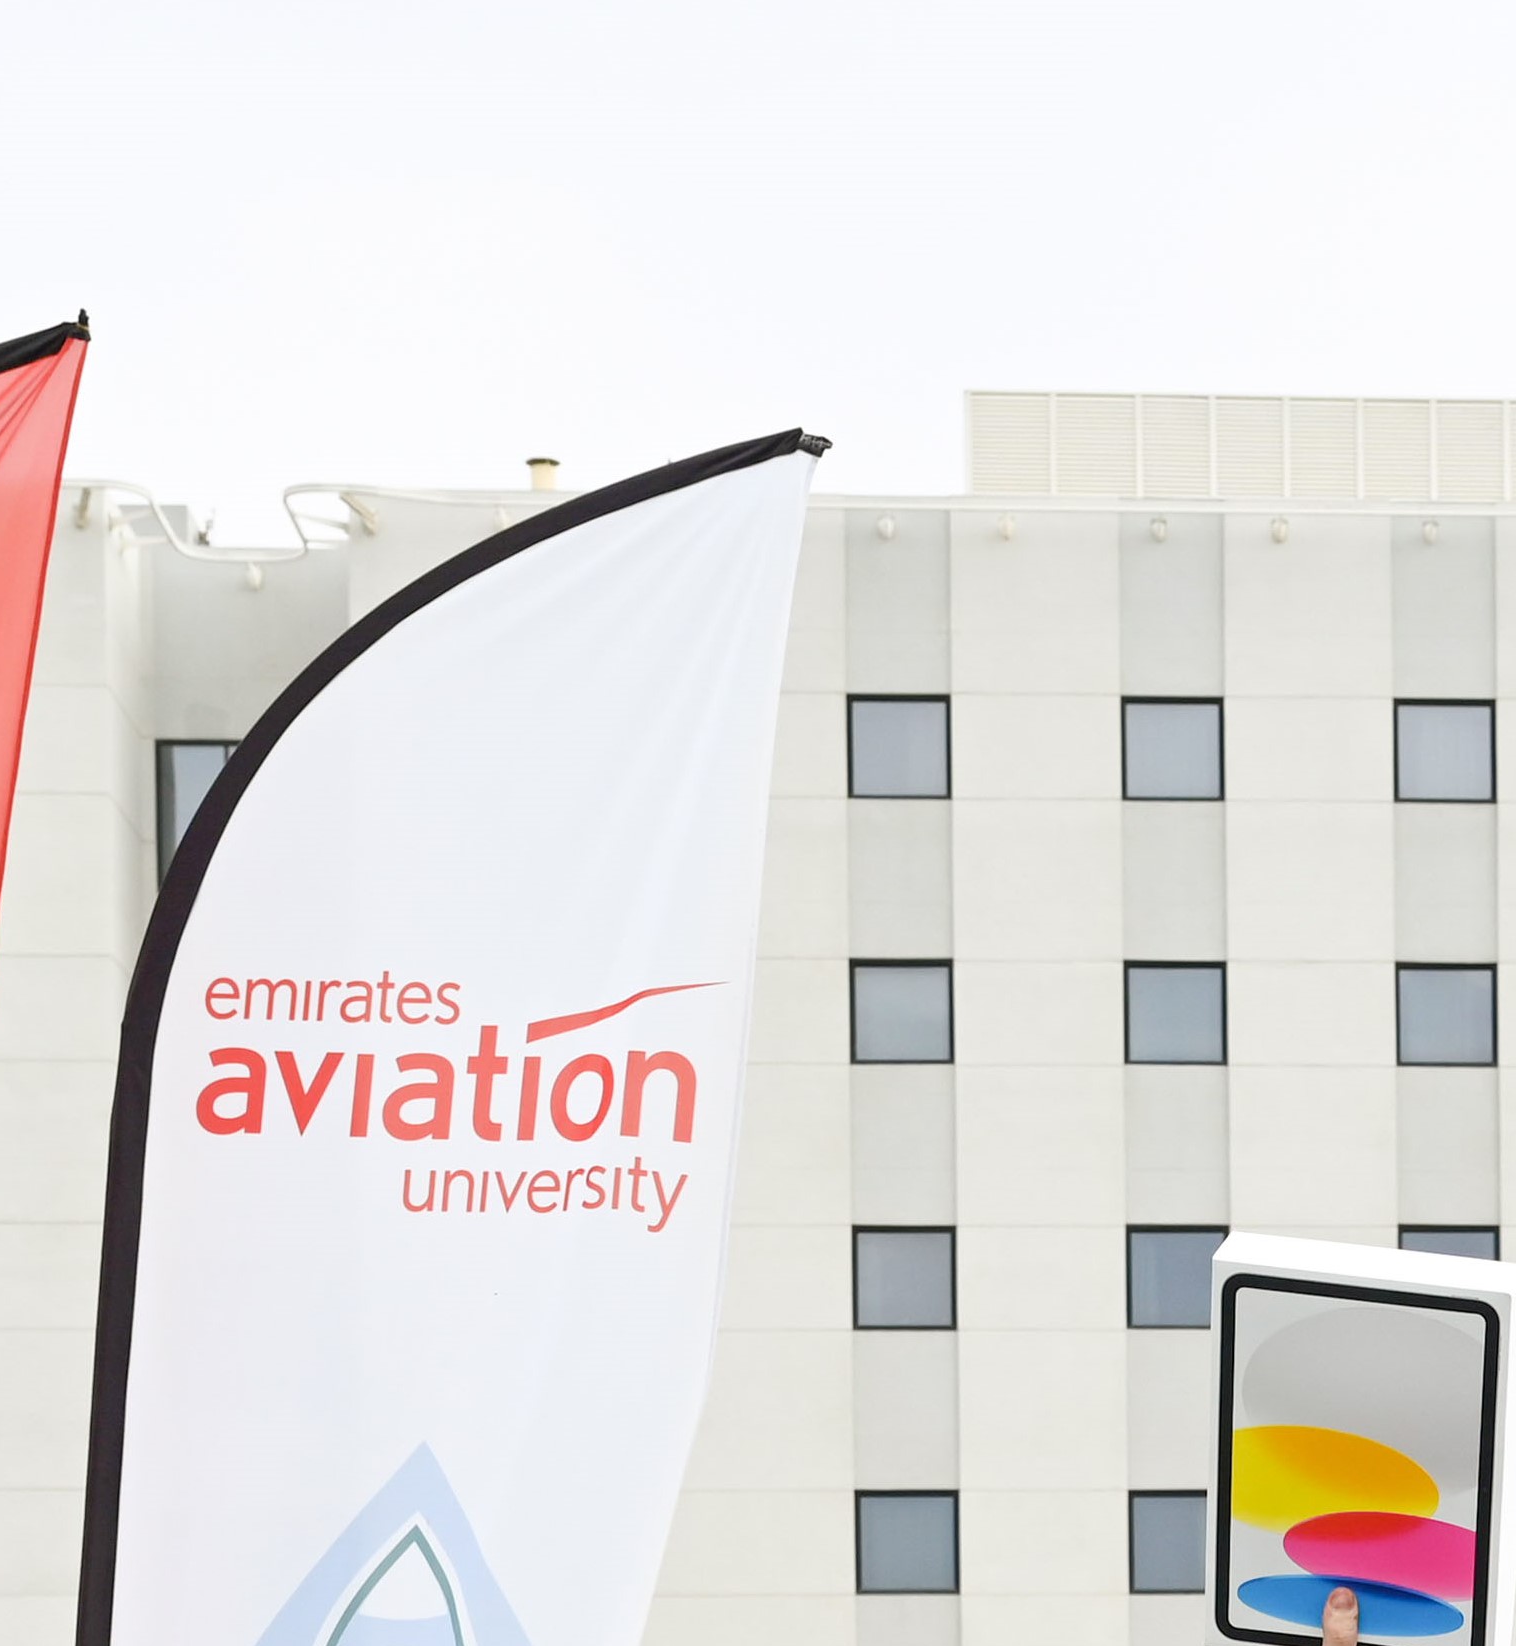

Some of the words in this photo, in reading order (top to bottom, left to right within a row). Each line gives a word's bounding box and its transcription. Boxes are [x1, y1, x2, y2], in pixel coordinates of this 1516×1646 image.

[204, 970, 462, 1026] emirates
[194, 1024, 698, 1144] aviation
[401, 1156, 689, 1233] university
